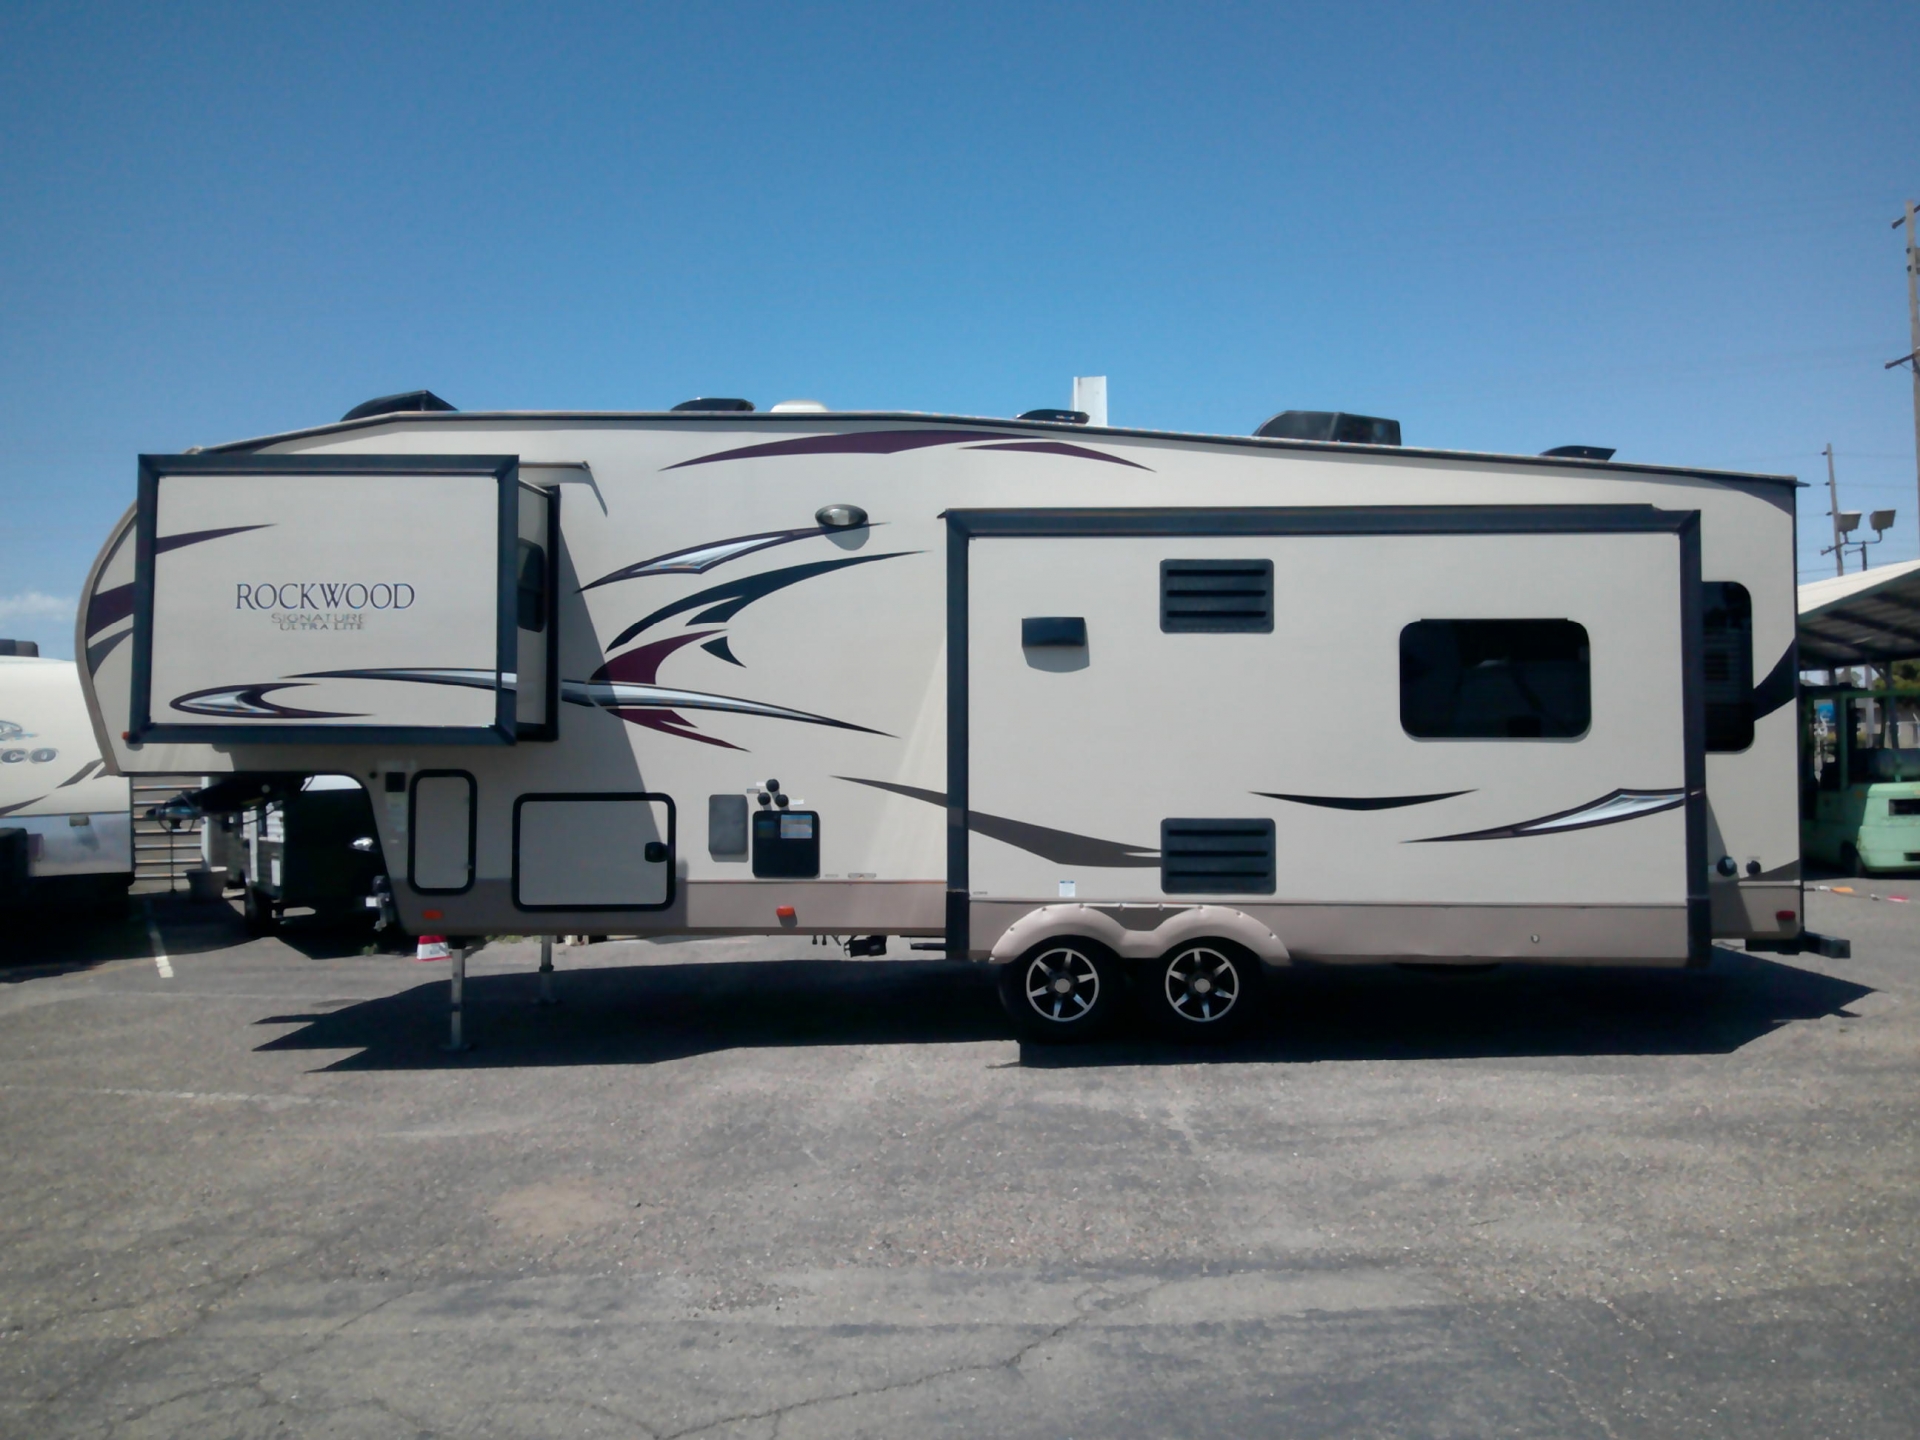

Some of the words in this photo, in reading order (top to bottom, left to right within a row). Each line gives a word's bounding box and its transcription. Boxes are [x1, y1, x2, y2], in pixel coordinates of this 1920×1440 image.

[236, 583, 415, 610] ROCKWOOD
[271, 613, 365, 623] SIGNATURE
[280, 623, 329, 631] ULTRA
[0, 748, 59, 764] CO
